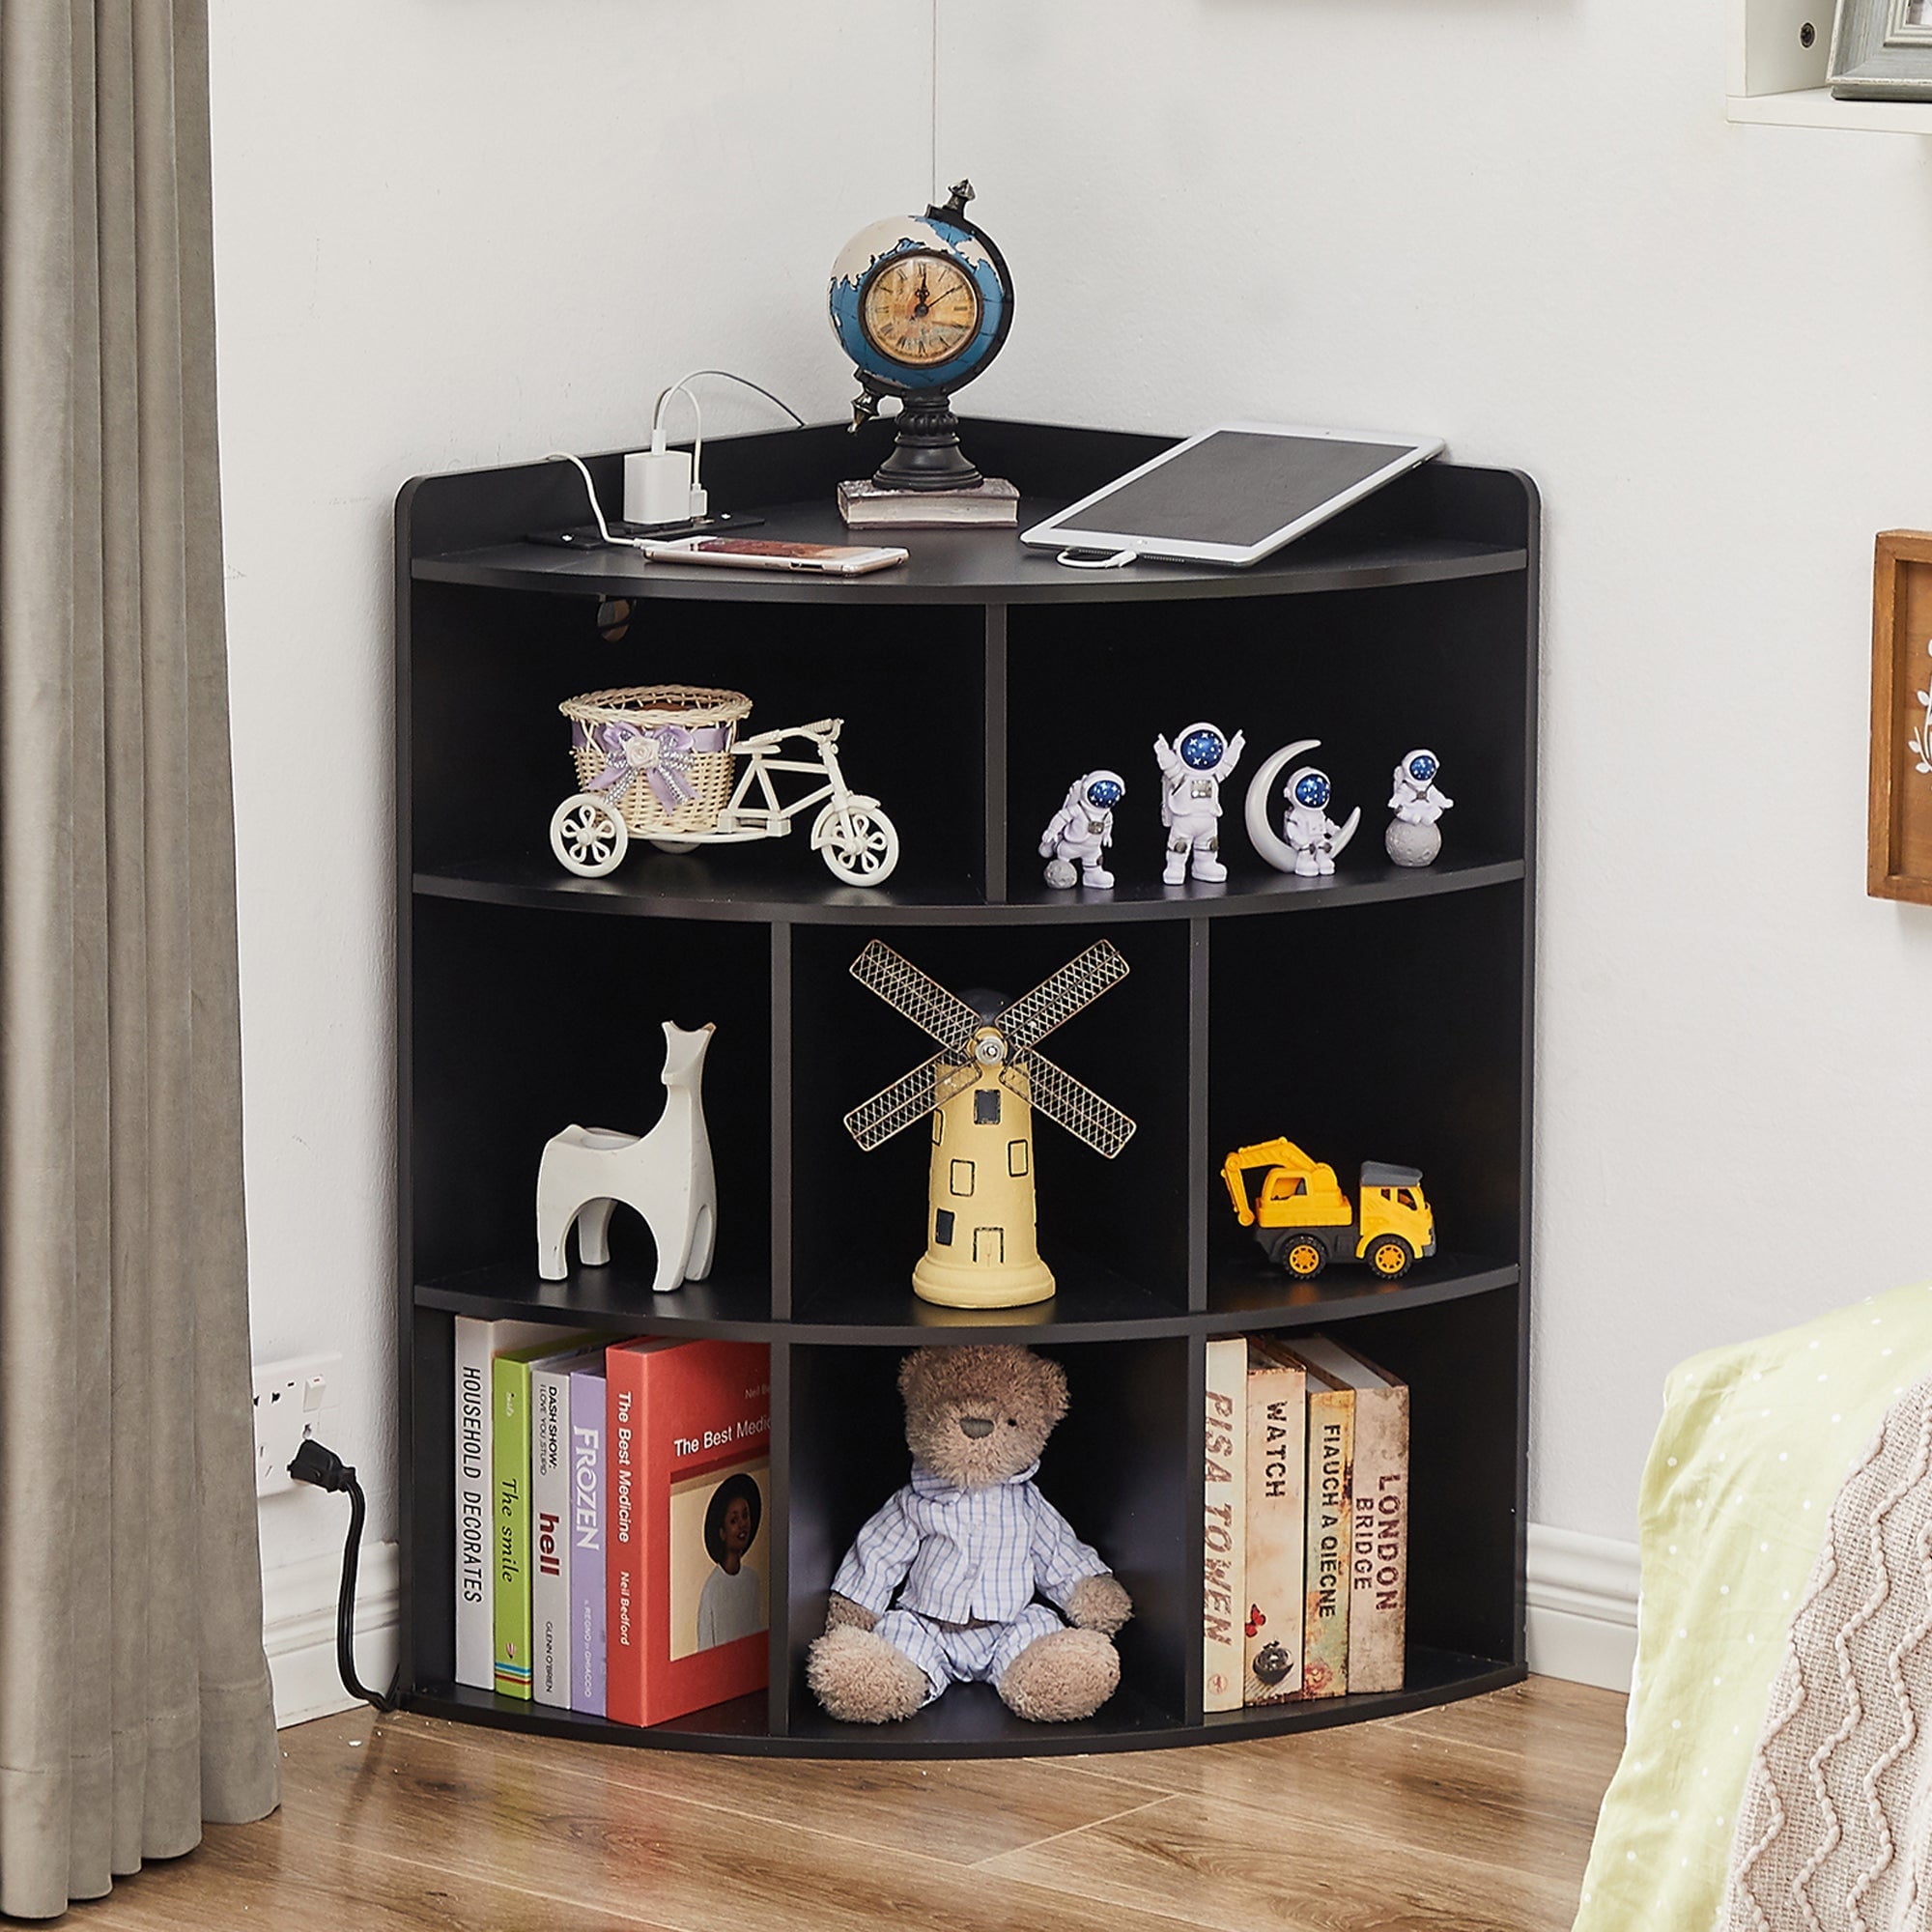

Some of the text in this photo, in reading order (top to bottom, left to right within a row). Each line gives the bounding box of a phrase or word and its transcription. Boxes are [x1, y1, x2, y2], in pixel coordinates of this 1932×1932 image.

[549, 1386, 557, 1469] DASH SHOW:
[618, 1391, 632, 1543] The Best Medicine
[673, 1437, 699, 1457] The
[703, 1426, 732, 1449] Best
[1205, 1391, 1234, 1483] PISA
[1265, 1401, 1288, 1497] WATCH
[1321, 1424, 1341, 1507] FIAUCH
[463, 1366, 482, 1604] HOUSEHOLD DECORATES
[501, 1478, 520, 1583] The smile
[573, 1425, 600, 1551] FROZEN
[1321, 1514, 1338, 1529] A
[540, 1513, 559, 1577] hell
[1354, 1497, 1375, 1590] BRIDGE
[1376, 1474, 1401, 1610] LONDON
[620, 1571, 631, 1646] Neil Bedford
